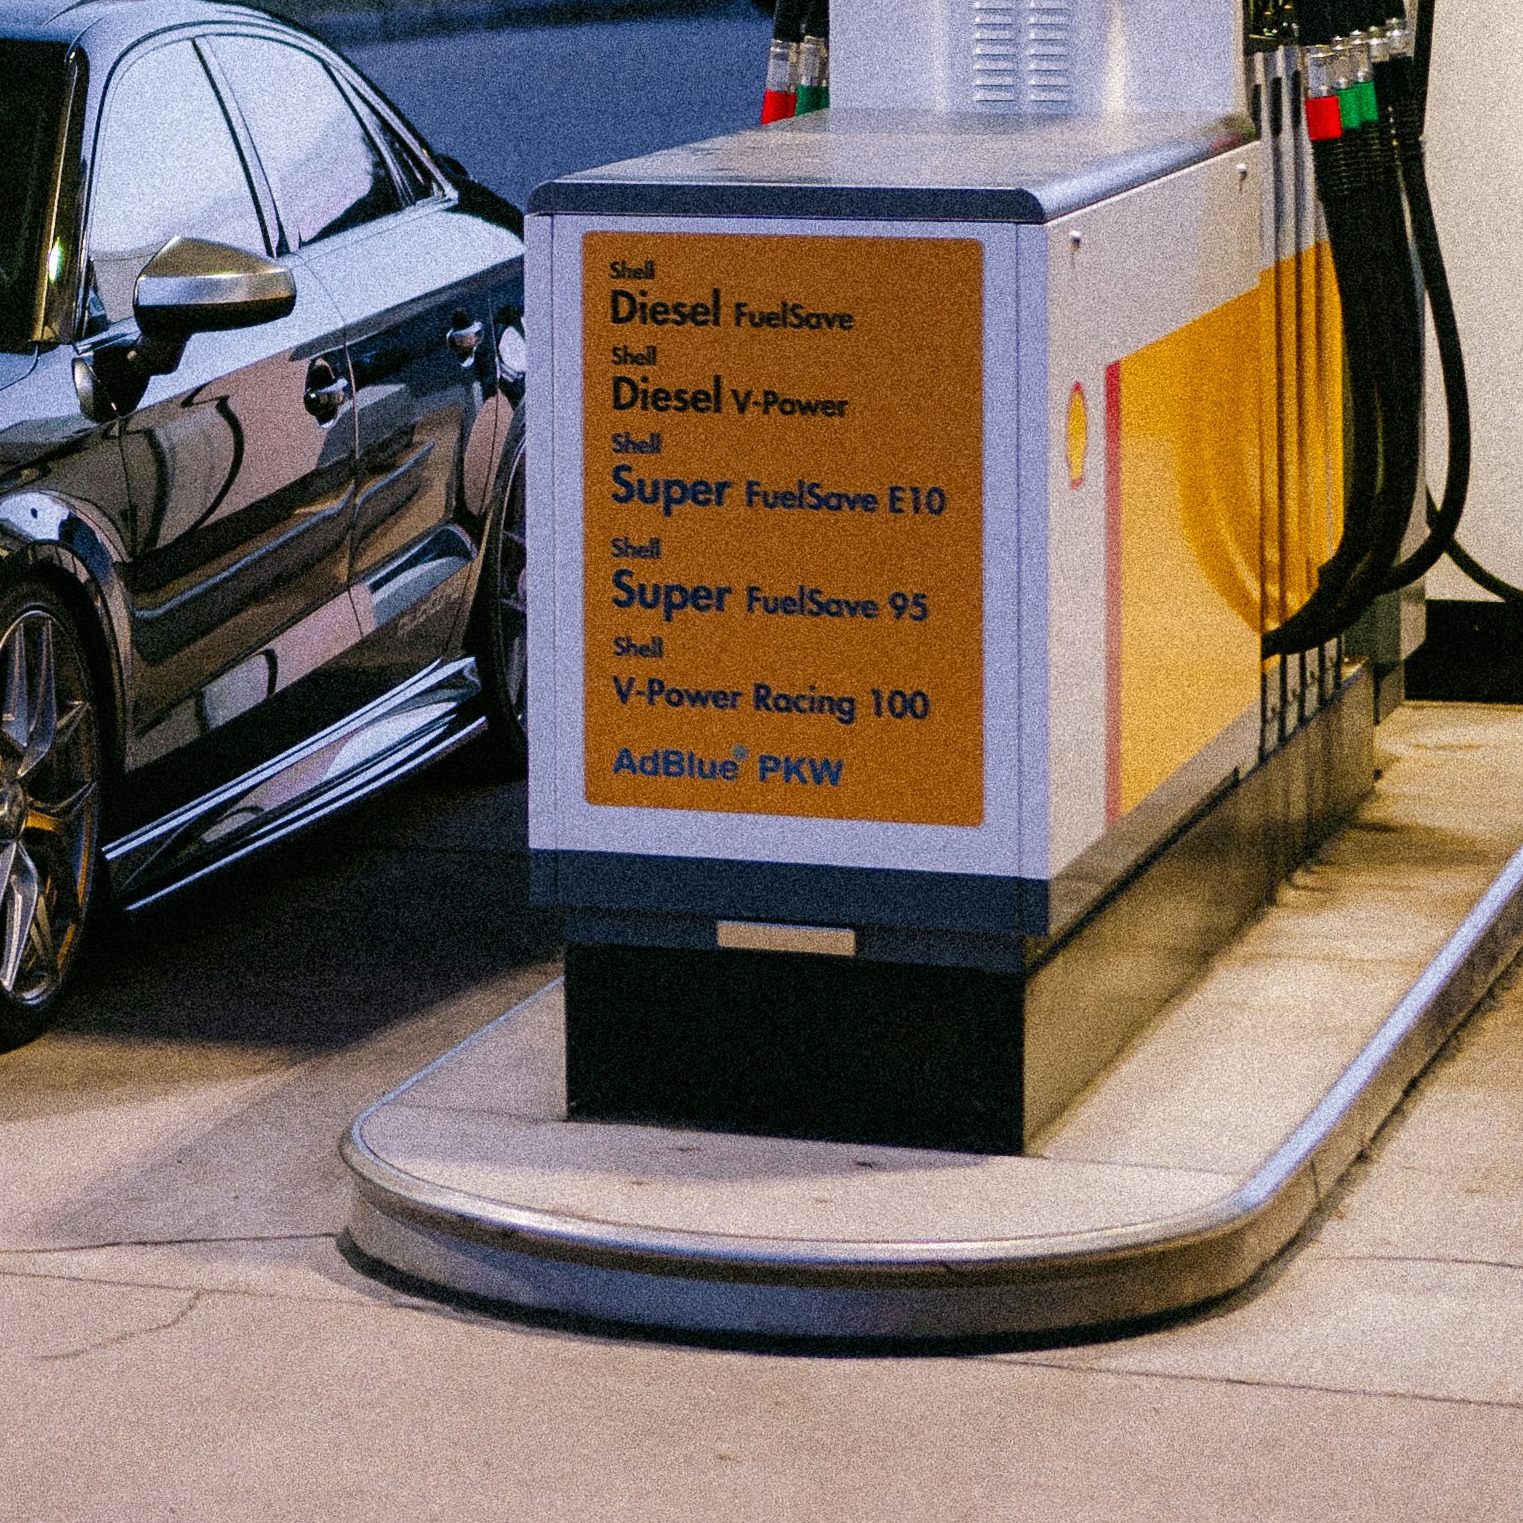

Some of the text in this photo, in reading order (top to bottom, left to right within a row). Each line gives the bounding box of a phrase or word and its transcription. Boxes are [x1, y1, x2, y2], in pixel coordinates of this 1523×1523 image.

[609, 260, 656, 280] Shell
[609, 287, 856, 331] Diesel FuelSave
[610, 345, 658, 367] Shell
[611, 374, 849, 419] Diesel V-Power
[610, 431, 663, 456] Shell
[610, 463, 949, 518] Super FuelSave E10
[610, 535, 663, 560] Shell
[611, 568, 930, 623] Super FuelSave 95
[612, 635, 665, 659] Shell
[611, 674, 932, 726] V-Power Racing 100
[757, 754, 845, 788] PKW
